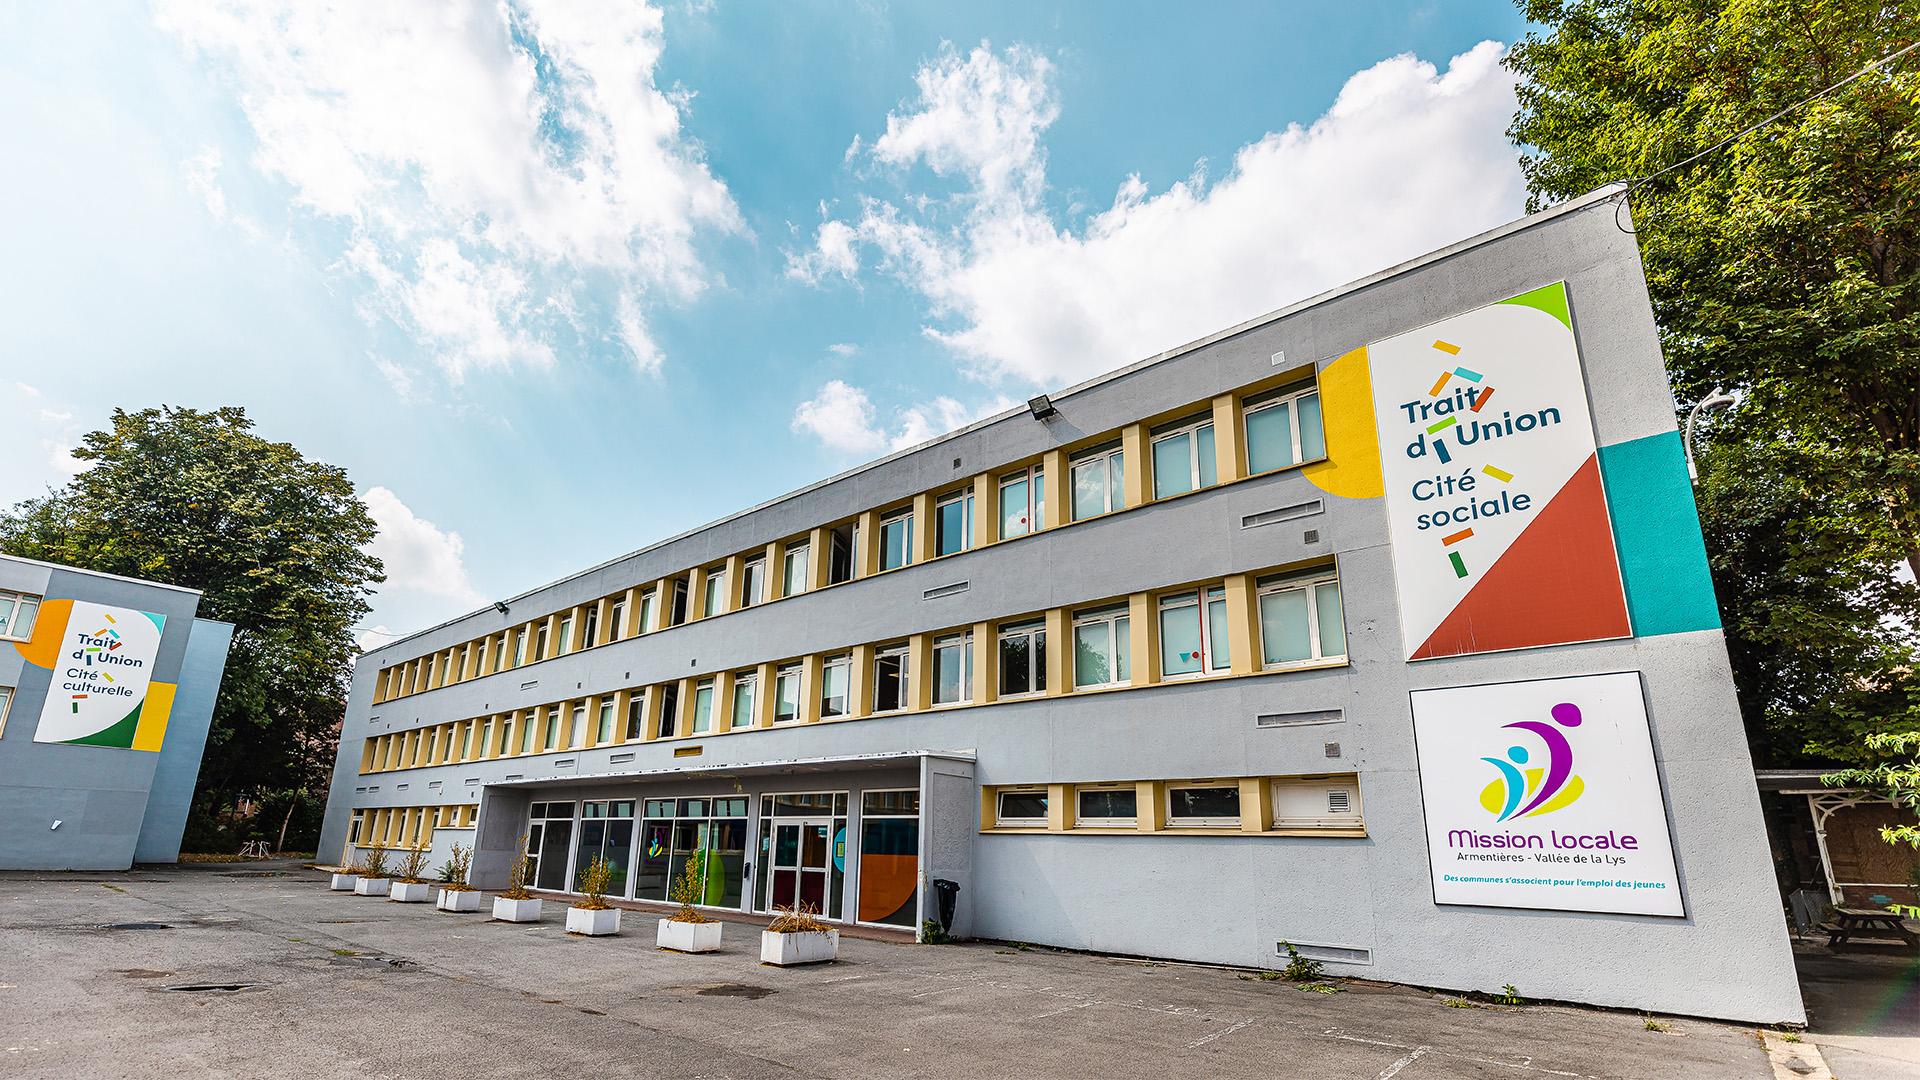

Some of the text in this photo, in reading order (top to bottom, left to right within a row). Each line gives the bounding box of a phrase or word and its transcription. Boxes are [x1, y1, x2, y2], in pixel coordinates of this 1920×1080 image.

[1400, 386, 1481, 424] Trait
[1456, 407, 1562, 446] Union
[1412, 467, 1476, 502] Cité
[1417, 491, 1531, 530] sociale
[78, 633, 116, 649] Trait
[66, 668, 98, 681] Cité
[63, 682, 133, 697] culturelle
[1448, 829, 1639, 850] Mission locale
[1457, 852, 1524, 862] Armentières
[1534, 853, 1570, 864] Vallée
[1573, 854, 1588, 864] de
[1590, 854, 1602, 864] la
[1605, 854, 1626, 866] Lys
[1443, 874, 1459, 882] Des
[1615, 880, 1632, 888] des
[1633, 880, 1666, 889] jeunes
